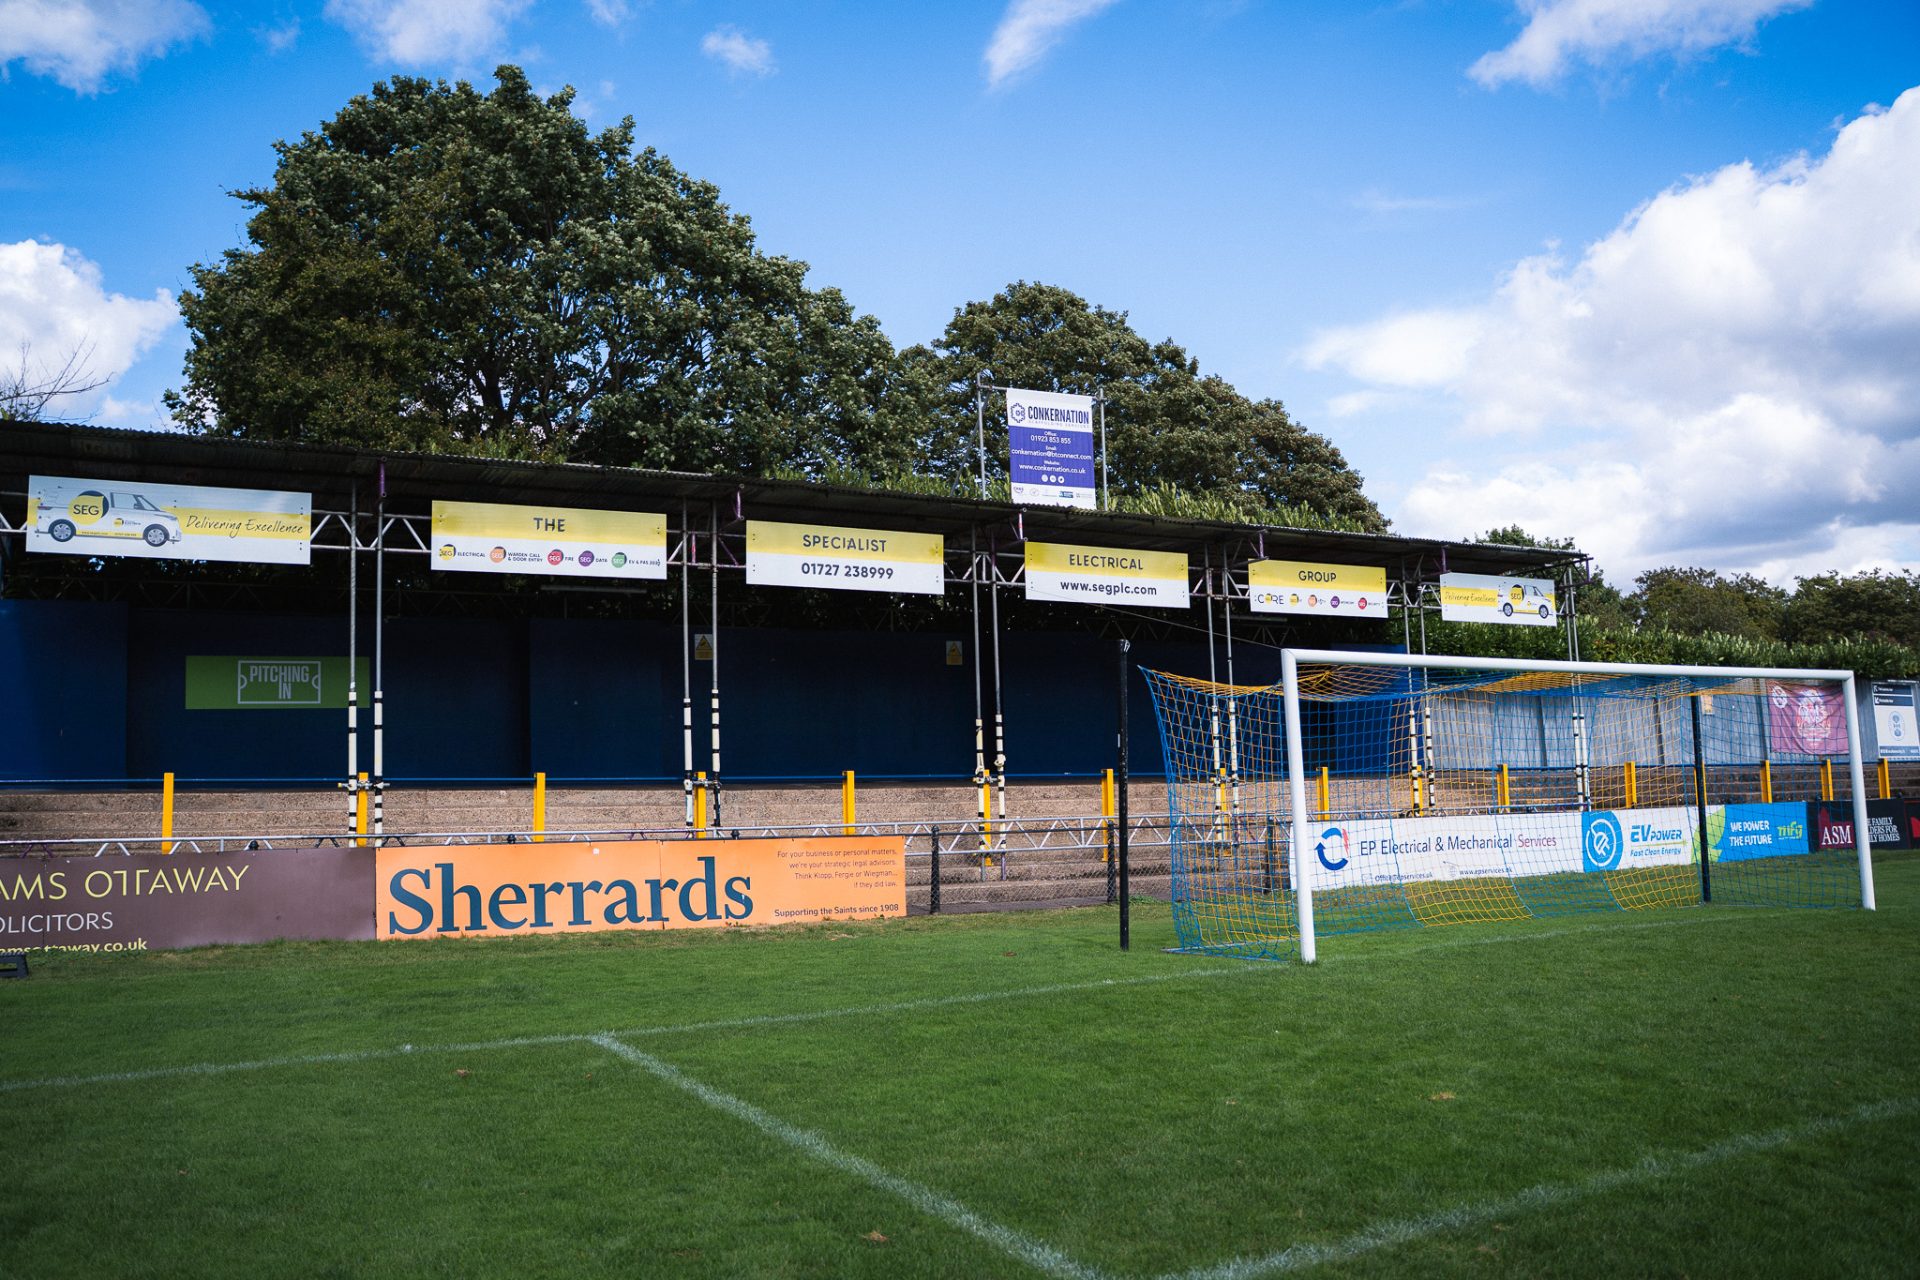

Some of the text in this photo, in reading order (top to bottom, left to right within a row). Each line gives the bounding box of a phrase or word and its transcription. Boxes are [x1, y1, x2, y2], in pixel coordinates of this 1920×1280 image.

[1028, 406, 1089, 425] CONKERNATION
[1019, 463, 1086, 474] www.conkernation.co.uk
[73, 504, 100, 516] SEG
[185, 515, 303, 538] Delivering Excellence
[533, 517, 566, 532] THE
[802, 534, 887, 552] SPECIALIST
[1069, 553, 1144, 570] ELECTRICAL
[801, 562, 894, 580] 01727 238999
[1298, 570, 1337, 582] GROUP
[1060, 581, 1157, 596] www.segplc.com
[1511, 592, 1521, 600] SEG
[250, 665, 309, 683] PITCHING
[279, 682, 292, 700] IN
[1730, 820, 1770, 832] WE POWER
[1872, 817, 1893, 825] FAMILY
[1777, 821, 1803, 839] mfg
[1821, 825, 1852, 845] ASM
[1885, 825, 1898, 833] FOR
[1360, 833, 1557, 856] EP Electrical & Mechanical Services
[1729, 834, 1773, 847] THE FUTURE
[1878, 833, 1900, 842] HOMES
[843, 849, 870, 857] personal
[1631, 847, 1682, 857] Fast Clean Energy
[85, 865, 249, 899] OTTAWAY
[834, 871, 854, 879] Fergie
[859, 881, 873, 889] they
[389, 856, 754, 935] Sherrards
[774, 903, 899, 918] Supporting the Saints since 1908
